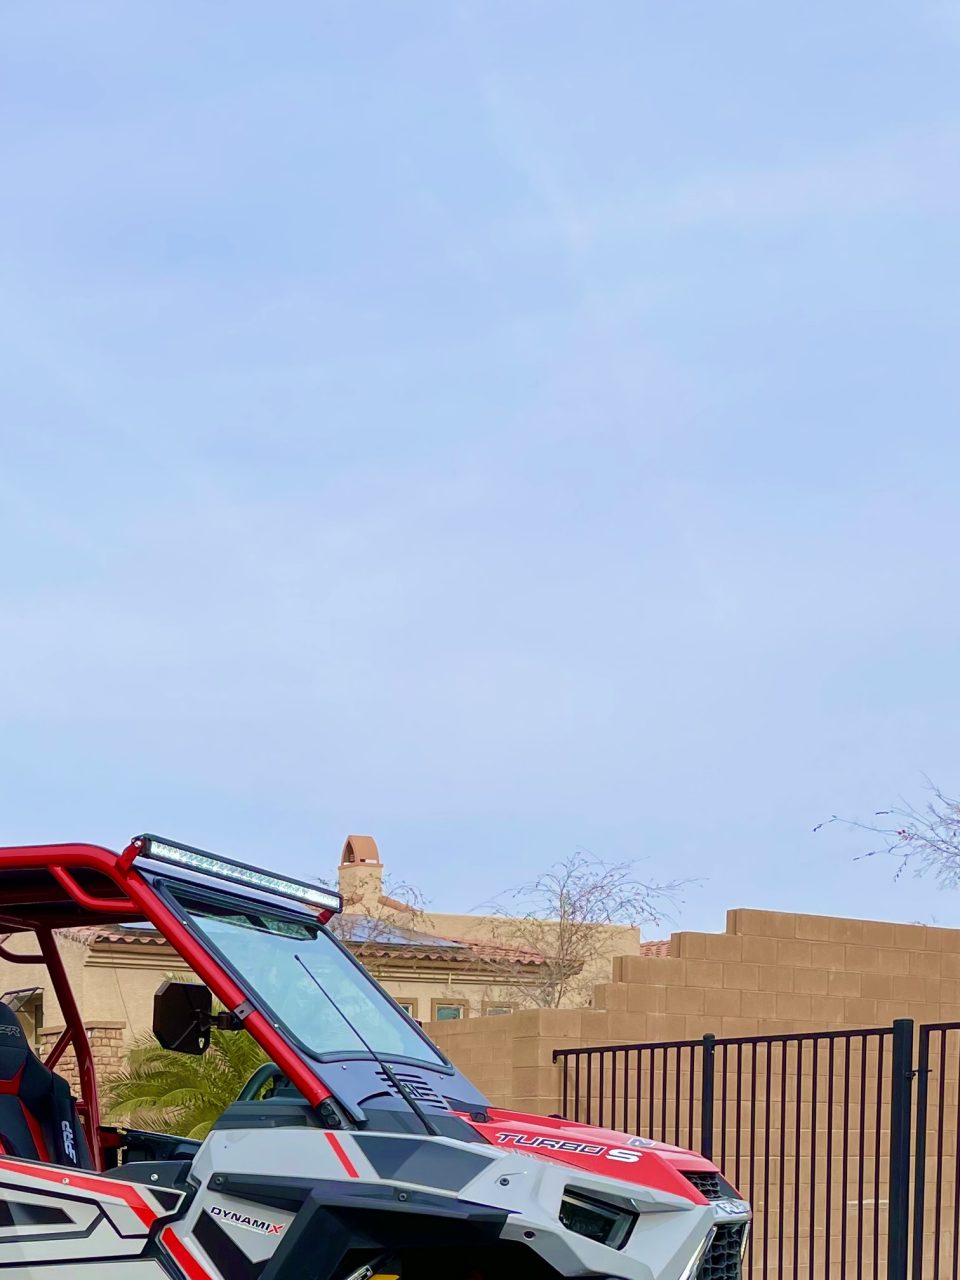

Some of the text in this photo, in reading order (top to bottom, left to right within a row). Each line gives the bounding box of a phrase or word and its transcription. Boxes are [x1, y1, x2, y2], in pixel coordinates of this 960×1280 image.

[496, 1132, 607, 1156] TURBO
[605, 1149, 643, 1163] S
[210, 1206, 284, 1234] DYNAMIX
